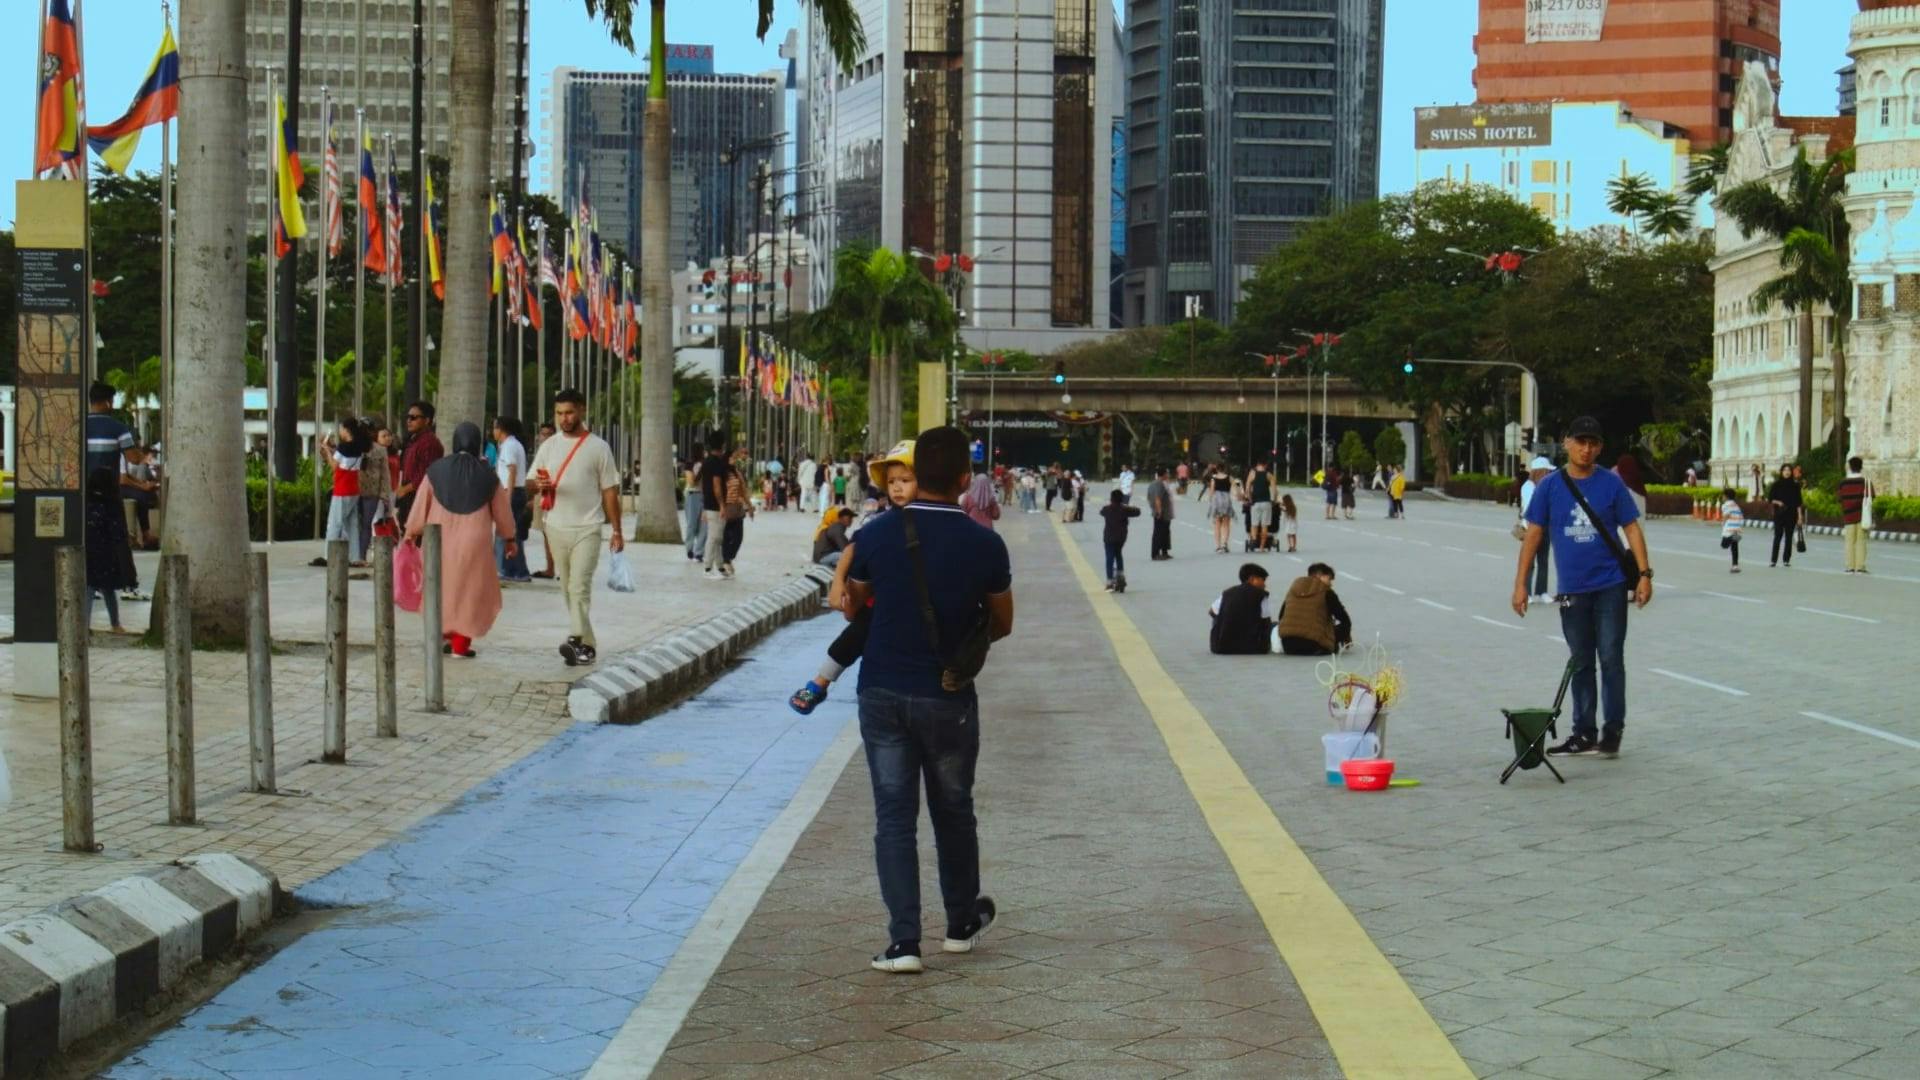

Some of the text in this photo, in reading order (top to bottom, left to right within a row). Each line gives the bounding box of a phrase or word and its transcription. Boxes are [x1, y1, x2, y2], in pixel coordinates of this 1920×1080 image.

[665, 45, 712, 59] ARA
[1430, 126, 1537, 141] SWISS HOTEL
